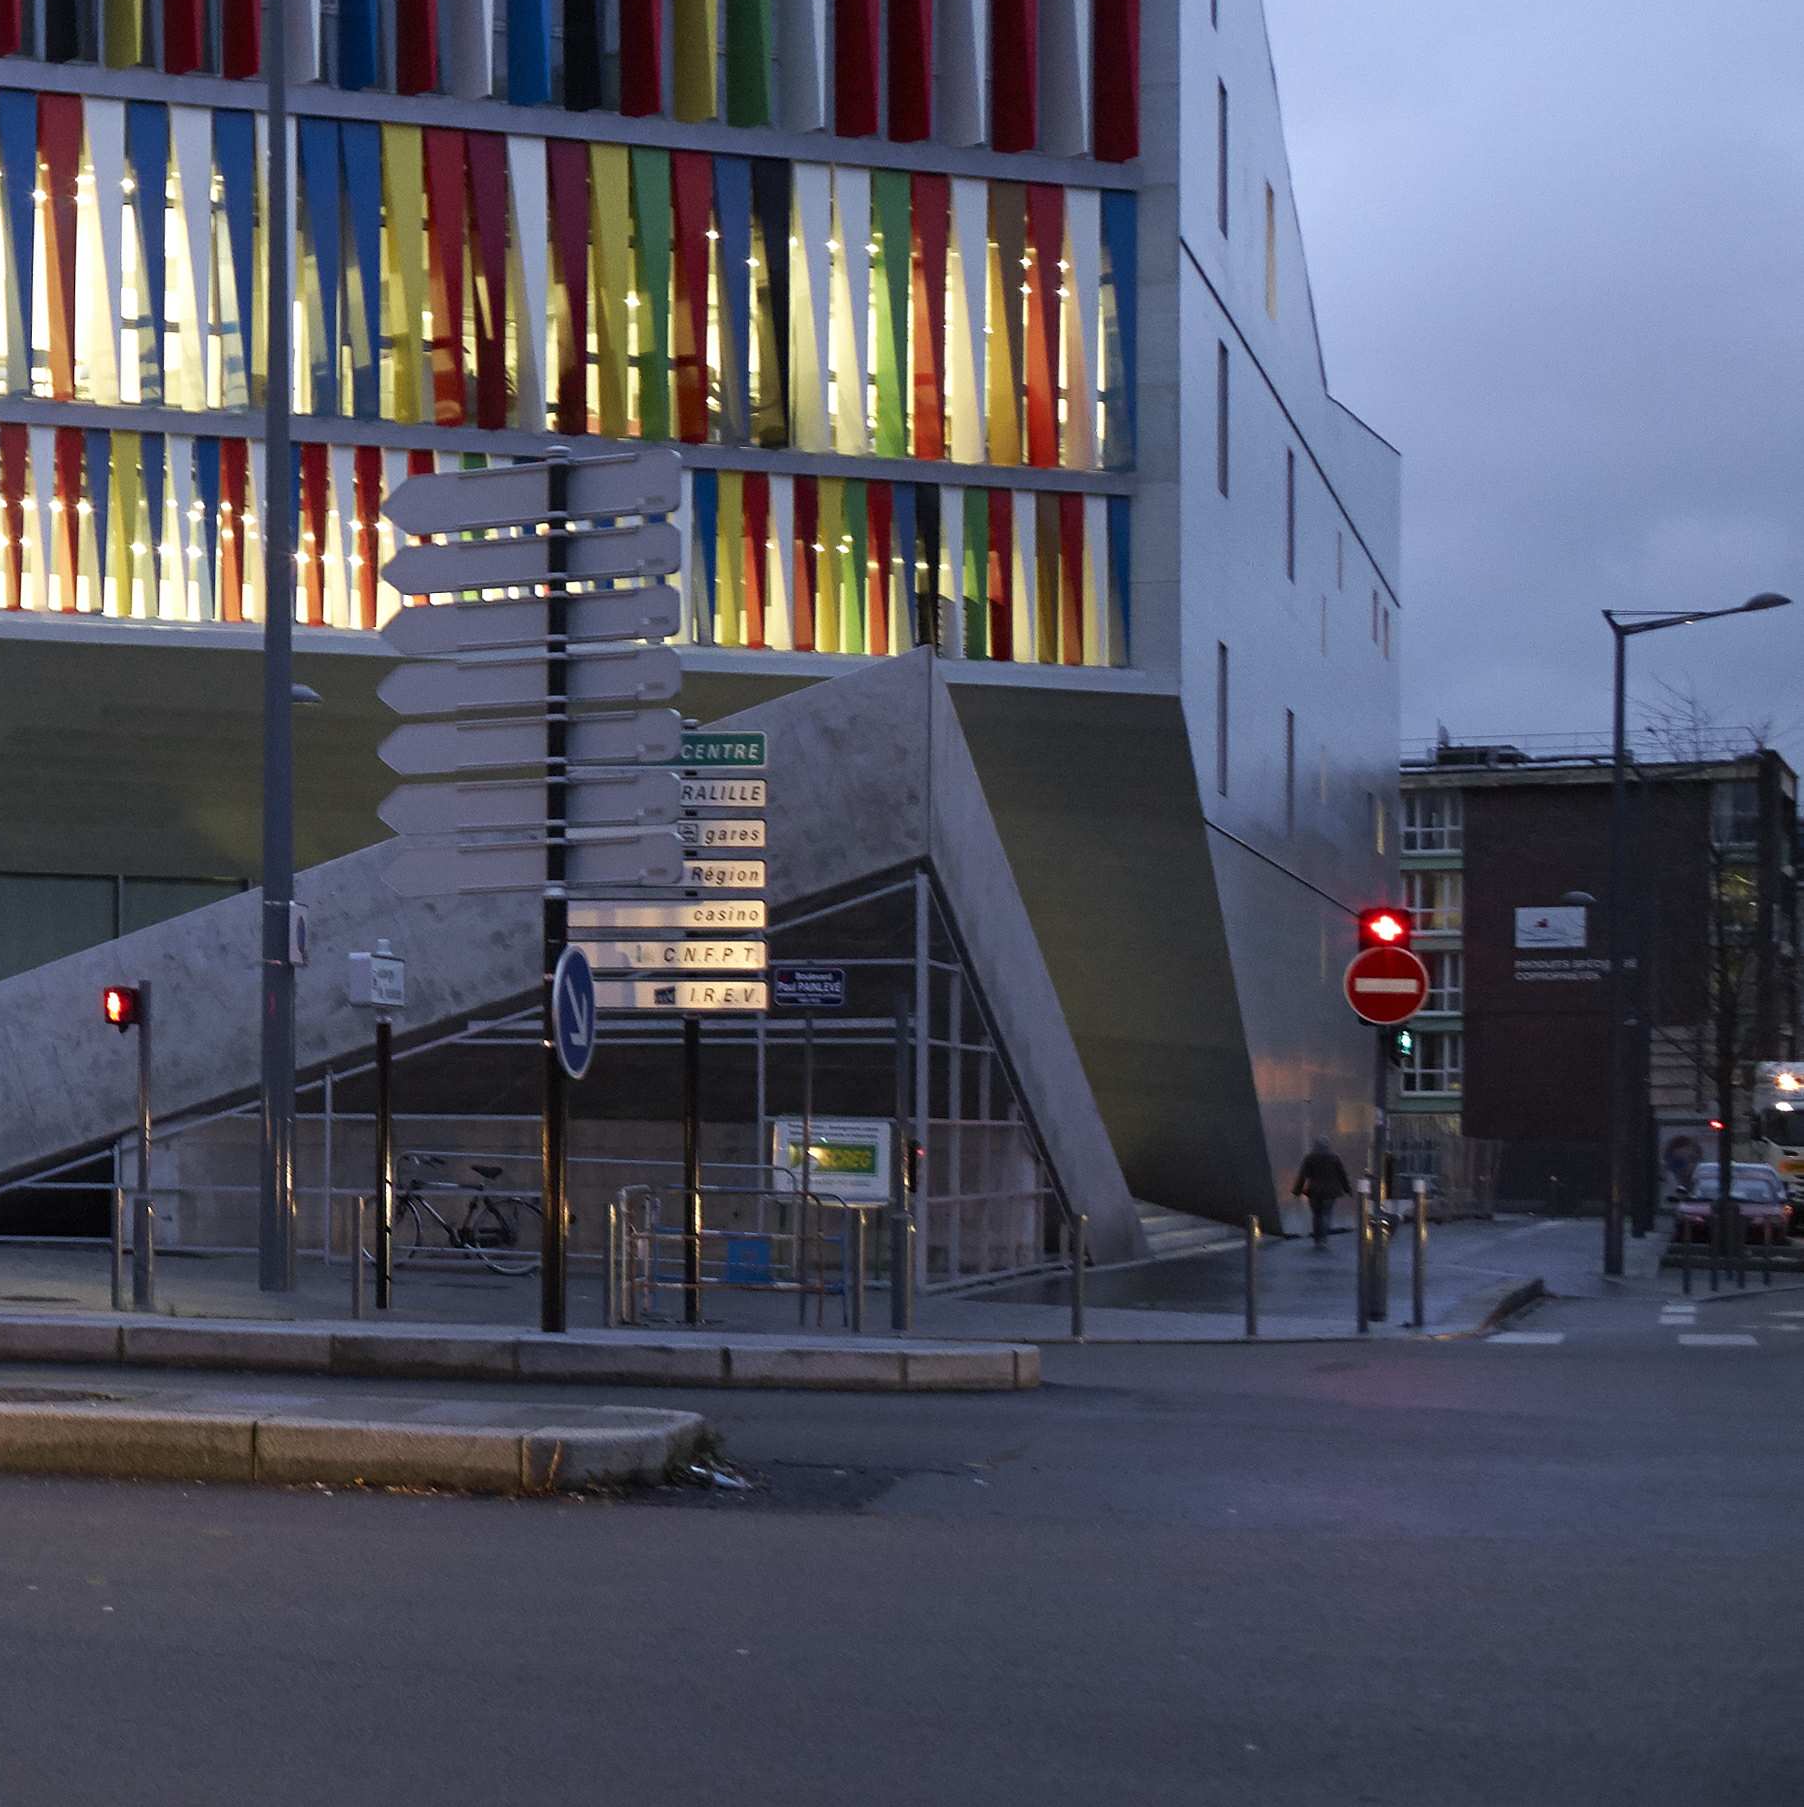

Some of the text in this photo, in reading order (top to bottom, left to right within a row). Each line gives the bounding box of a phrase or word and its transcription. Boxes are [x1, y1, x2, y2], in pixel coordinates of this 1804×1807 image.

[681, 743, 760, 761] CENTRE
[681, 785, 761, 801] RALILLE
[705, 828, 760, 845] gares
[691, 866, 760, 886] Région
[694, 905, 759, 922] casino
